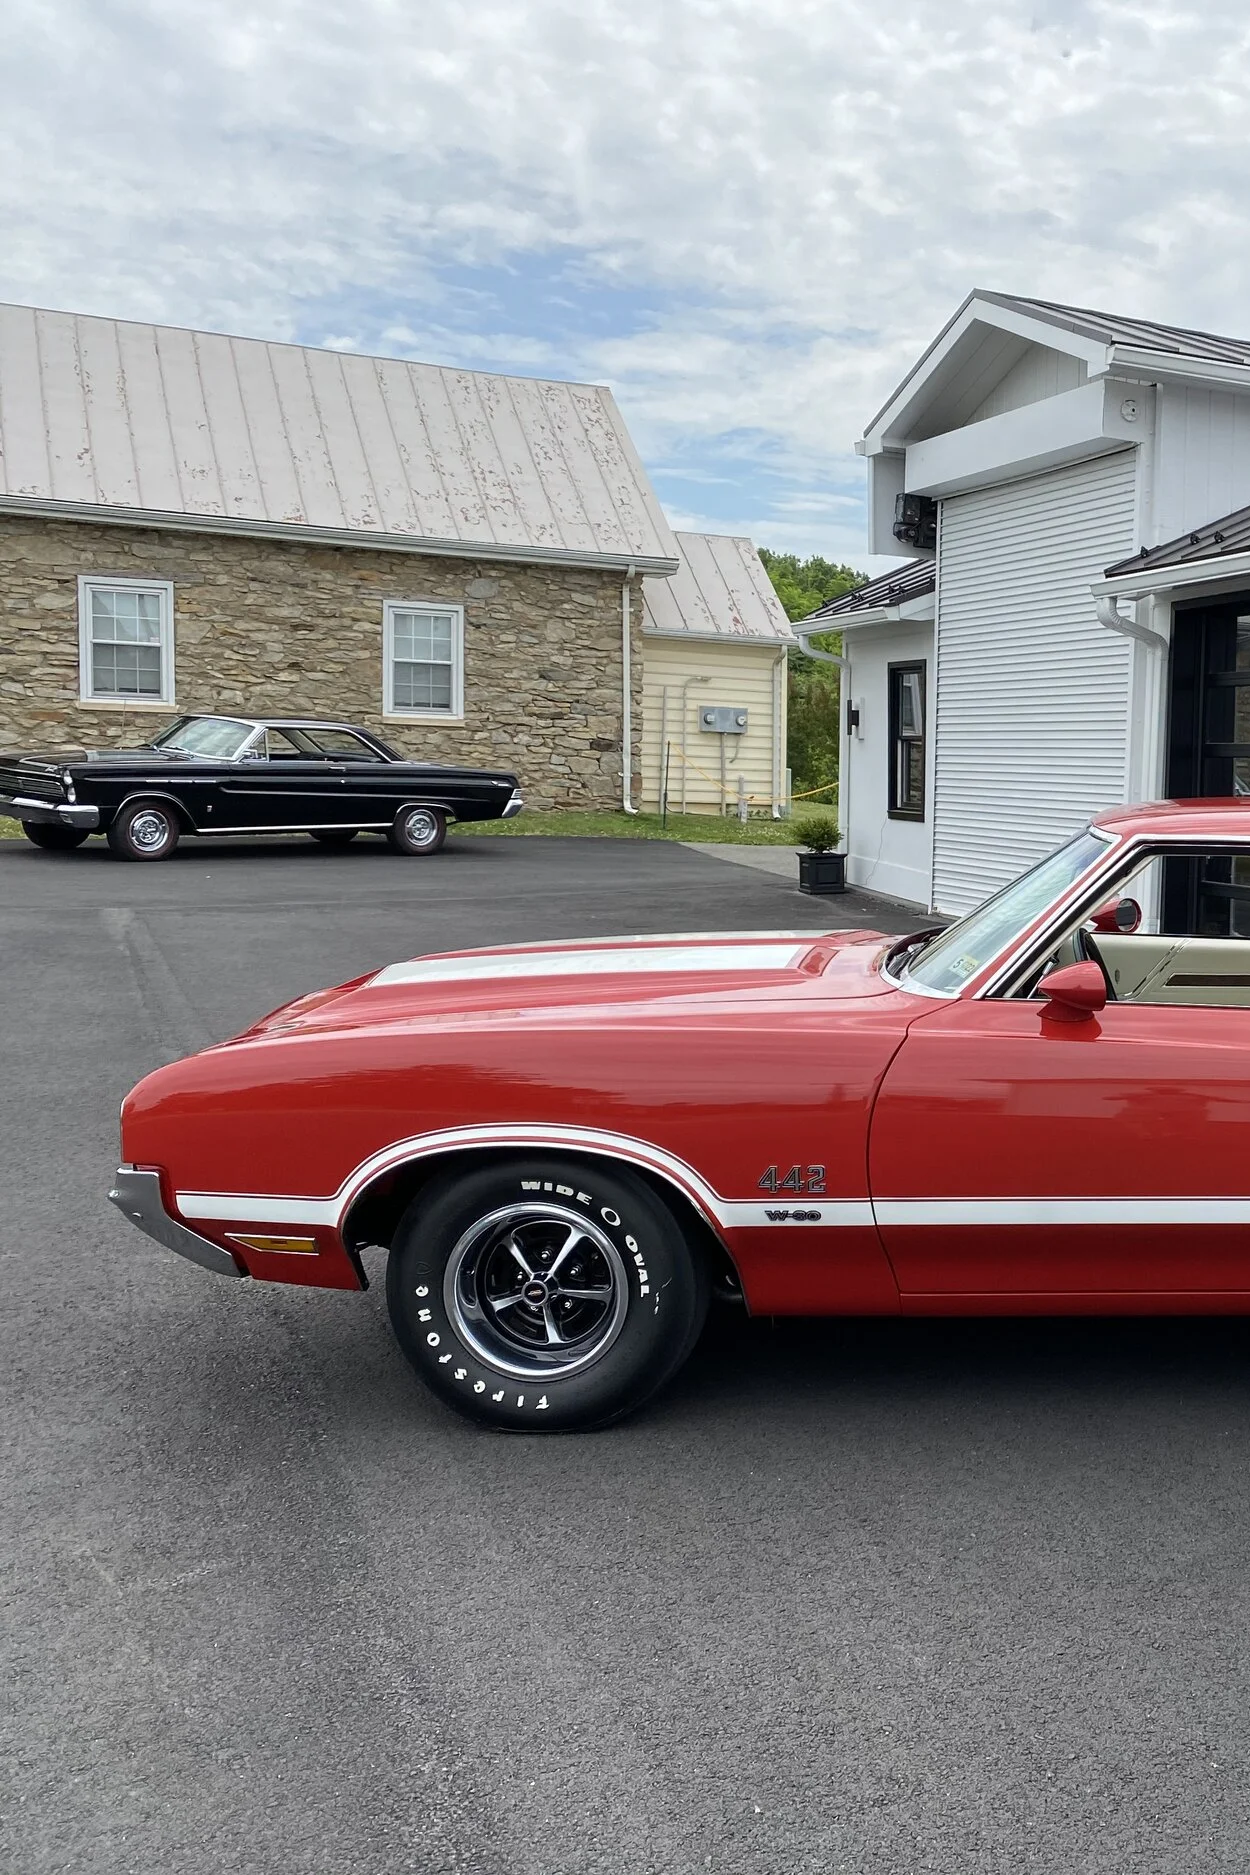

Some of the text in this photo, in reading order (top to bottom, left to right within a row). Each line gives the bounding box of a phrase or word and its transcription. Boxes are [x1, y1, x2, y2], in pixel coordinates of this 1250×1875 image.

[758, 1165, 827, 1194] 442
[764, 1209, 822, 1222] W-30
[521, 1180, 593, 1206] WIDE
[625, 1234, 650, 1298] OVAL
[415, 1285, 551, 1411] Firestone
